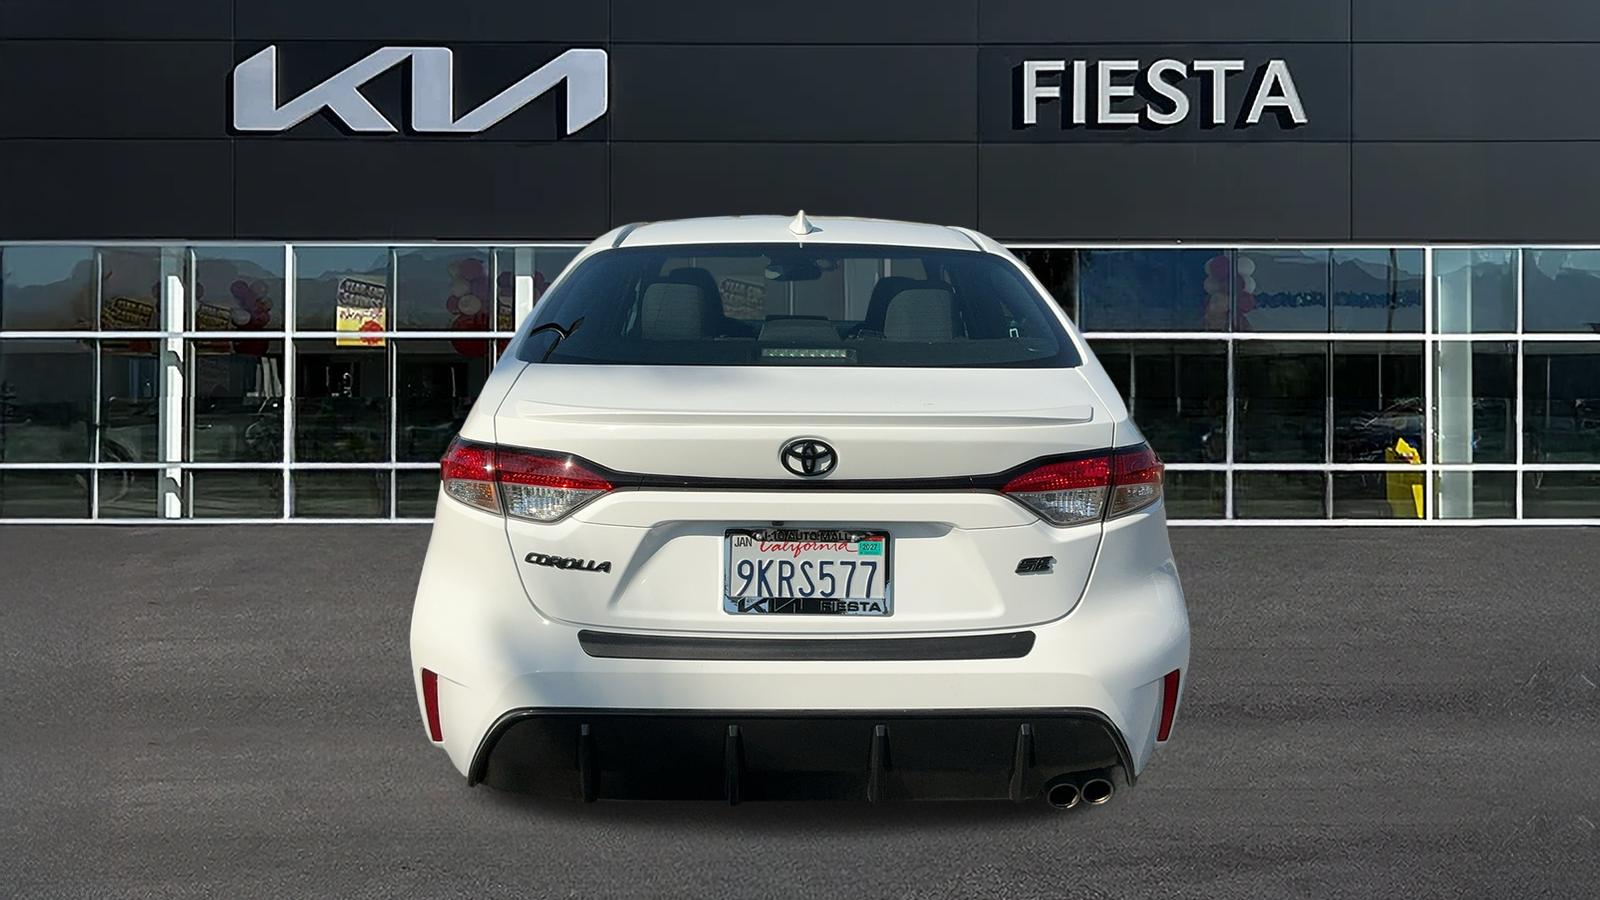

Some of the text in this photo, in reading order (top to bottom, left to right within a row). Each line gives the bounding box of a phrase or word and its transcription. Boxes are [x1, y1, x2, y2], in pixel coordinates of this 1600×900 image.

[233, 44, 608, 135] KIA
[1023, 59, 1308, 125] FIESTA
[734, 536, 753, 548] JAN
[787, 531, 818, 542] AUTO
[820, 531, 849, 542] MALL
[760, 539, 859, 558] California
[525, 552, 612, 574] COROLLA
[737, 559, 878, 599] 9KRS577
[820, 600, 882, 613] FIESTA
